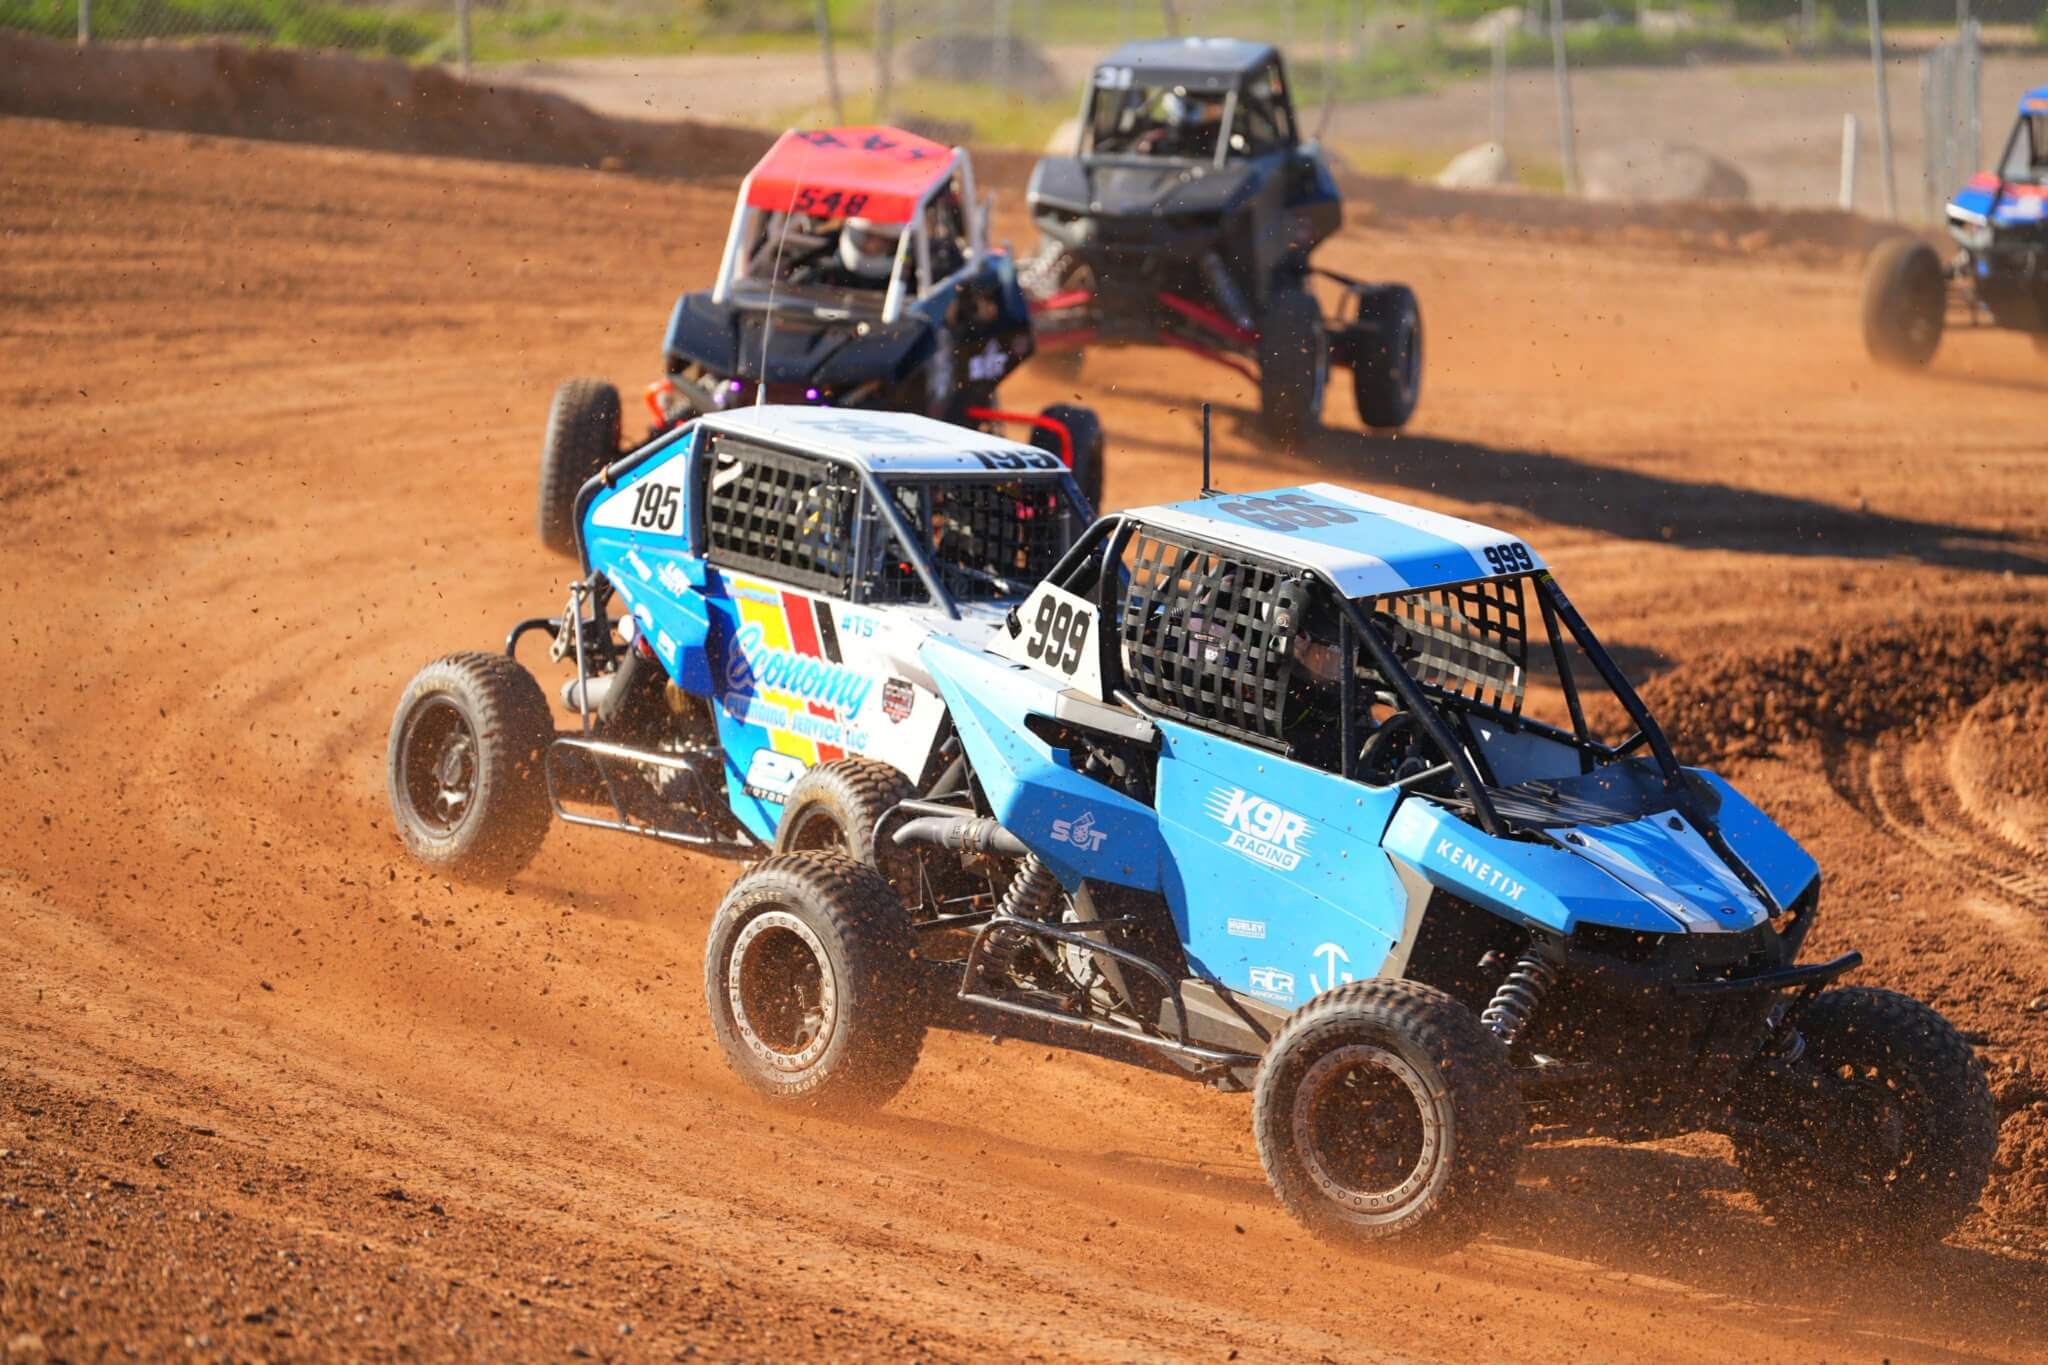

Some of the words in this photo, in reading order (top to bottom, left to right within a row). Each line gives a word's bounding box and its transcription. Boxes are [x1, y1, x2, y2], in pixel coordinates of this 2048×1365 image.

[795, 187, 869, 215] 548
[631, 481, 681, 531] 195
[1484, 542, 1534, 575] 999
[1027, 593, 1090, 676] 999
[728, 626, 874, 721] Economy
[1216, 786, 1312, 851] K9R
[1232, 835, 1294, 867] RACING
[1436, 838, 1527, 901] KENETIK
